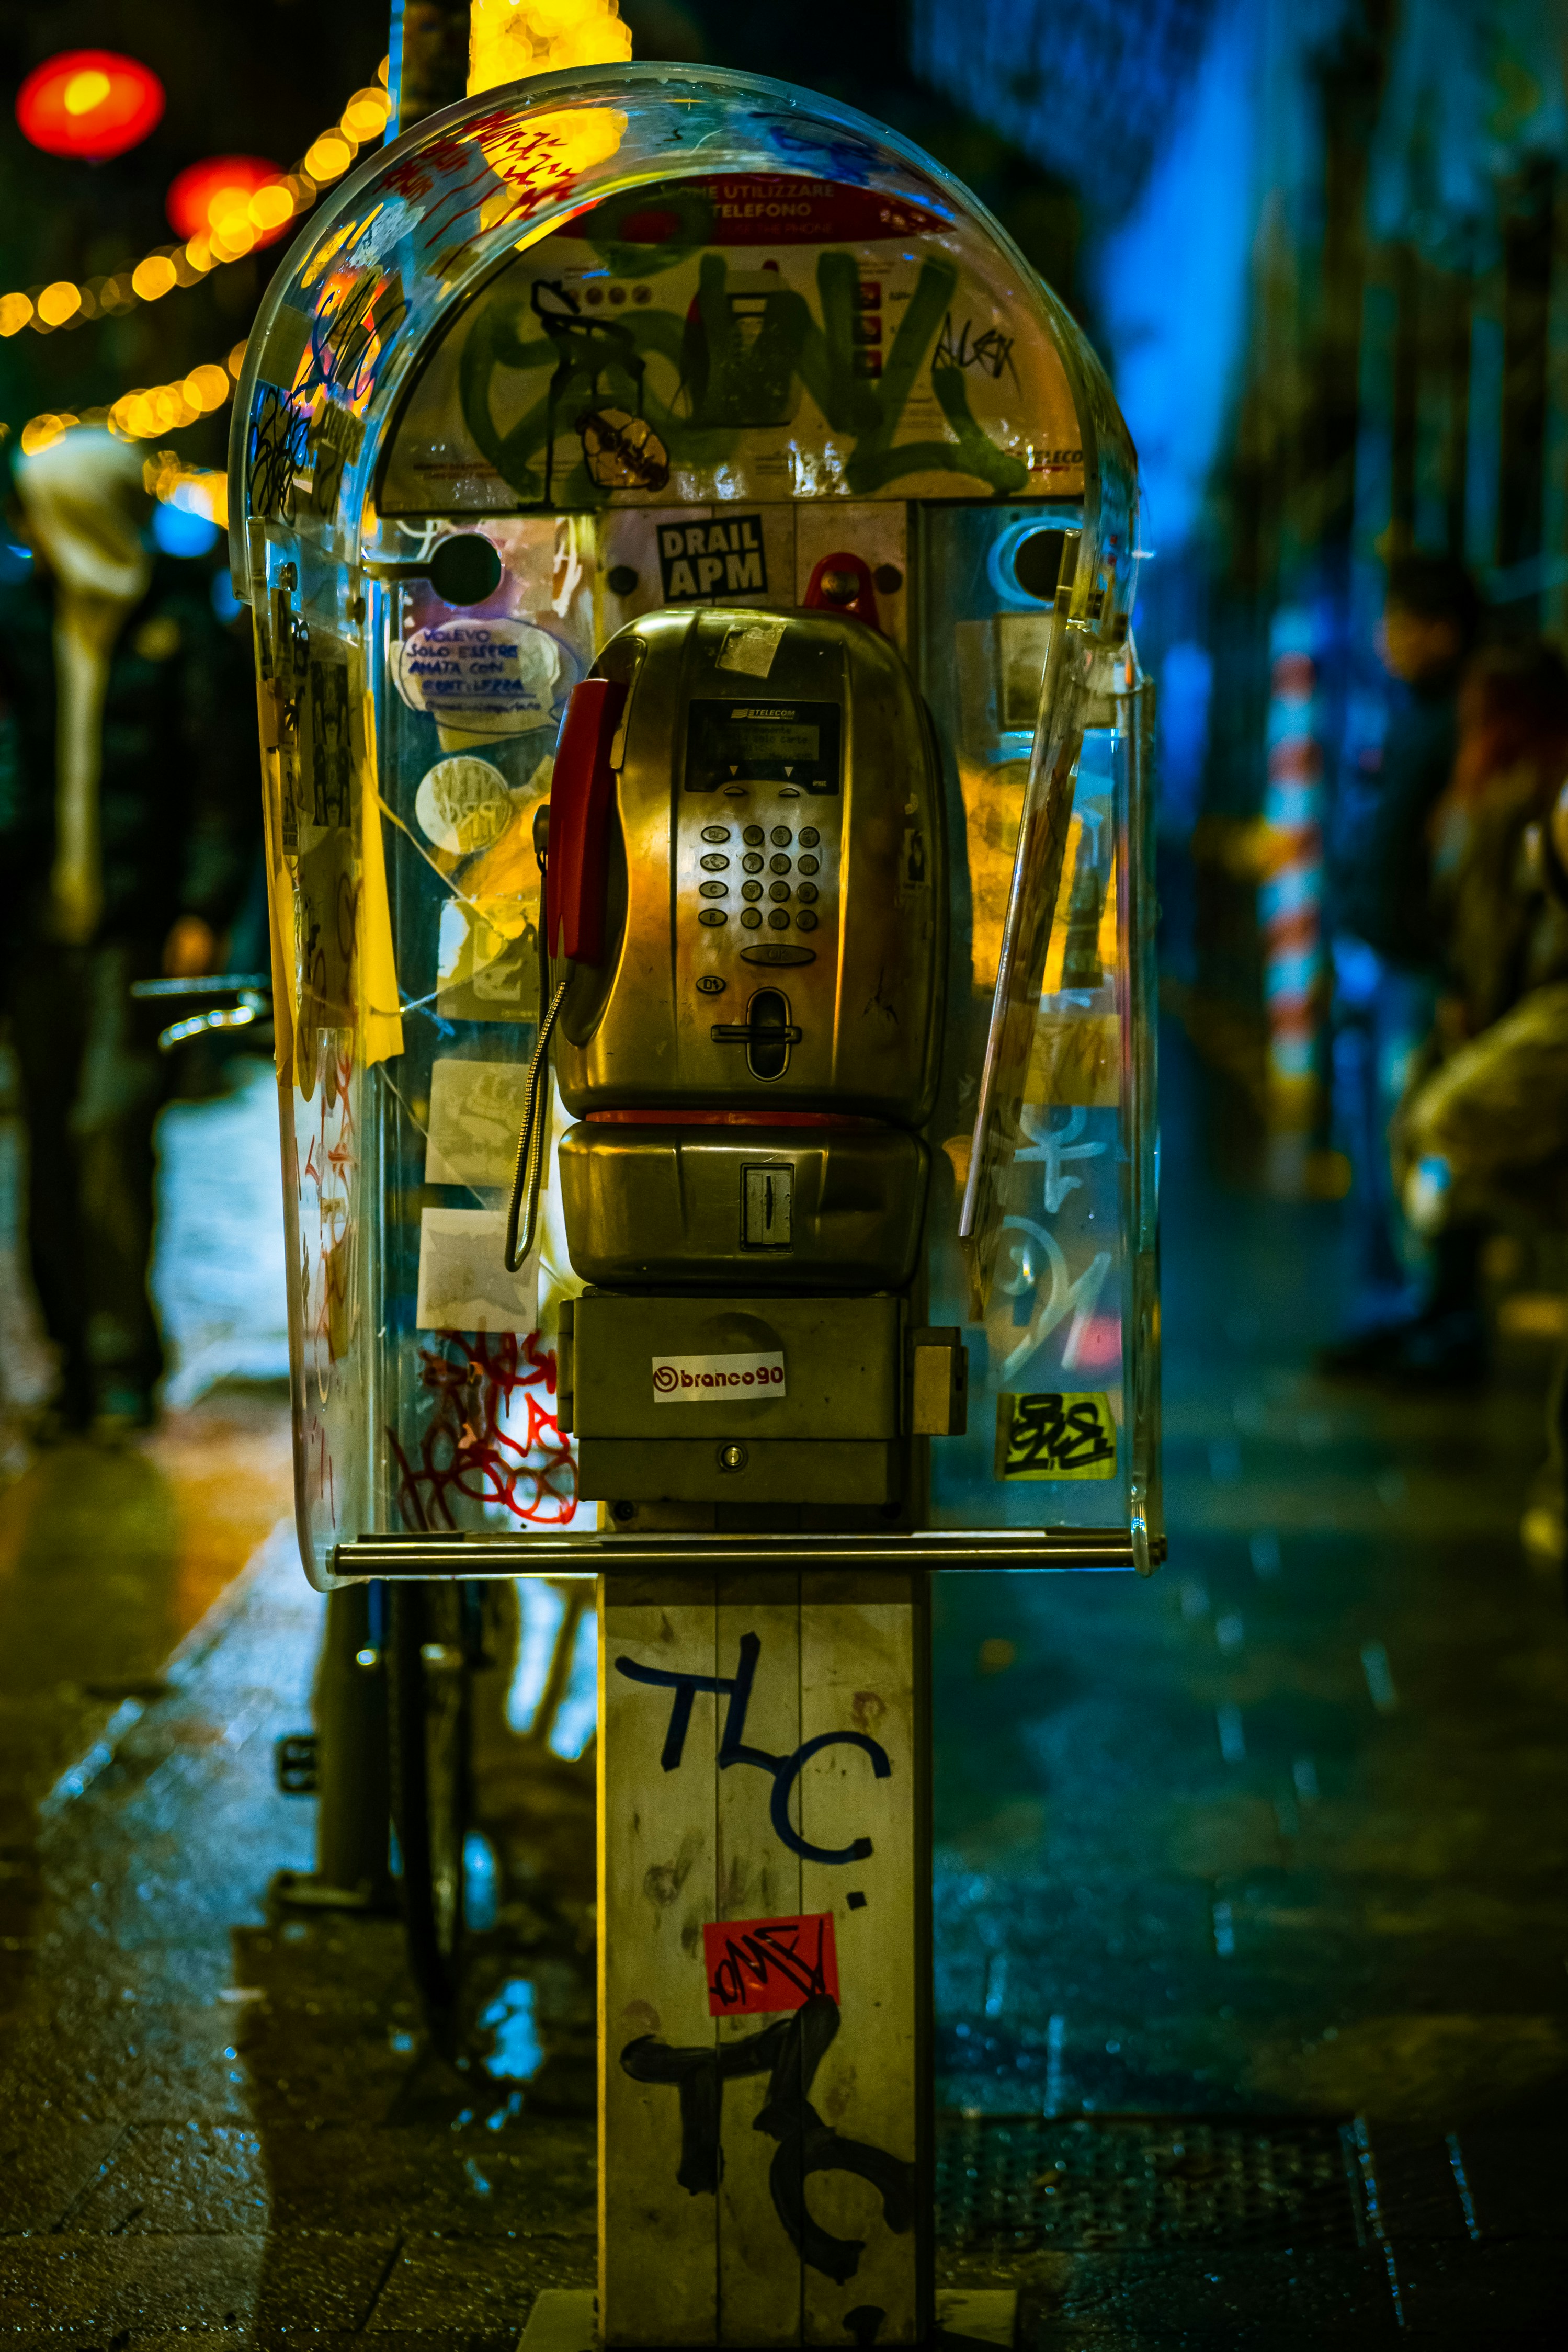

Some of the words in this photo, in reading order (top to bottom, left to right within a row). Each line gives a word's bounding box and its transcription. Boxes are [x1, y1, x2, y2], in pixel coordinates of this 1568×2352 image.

[723, 184, 834, 199] UTILIZZARE
[713, 202, 811, 218] TELEFONO
[785, 222, 833, 234] PHONE
[662, 520, 759, 559] DRAIL
[668, 551, 764, 597] APM
[423, 629, 491, 643] VOLEVO
[406, 643, 450, 657] SOLO
[408, 660, 462, 675] AMATA
[469, 661, 503, 675] CON
[709, 885, 718, 894] C
[680, 1366, 783, 1388] branco90
